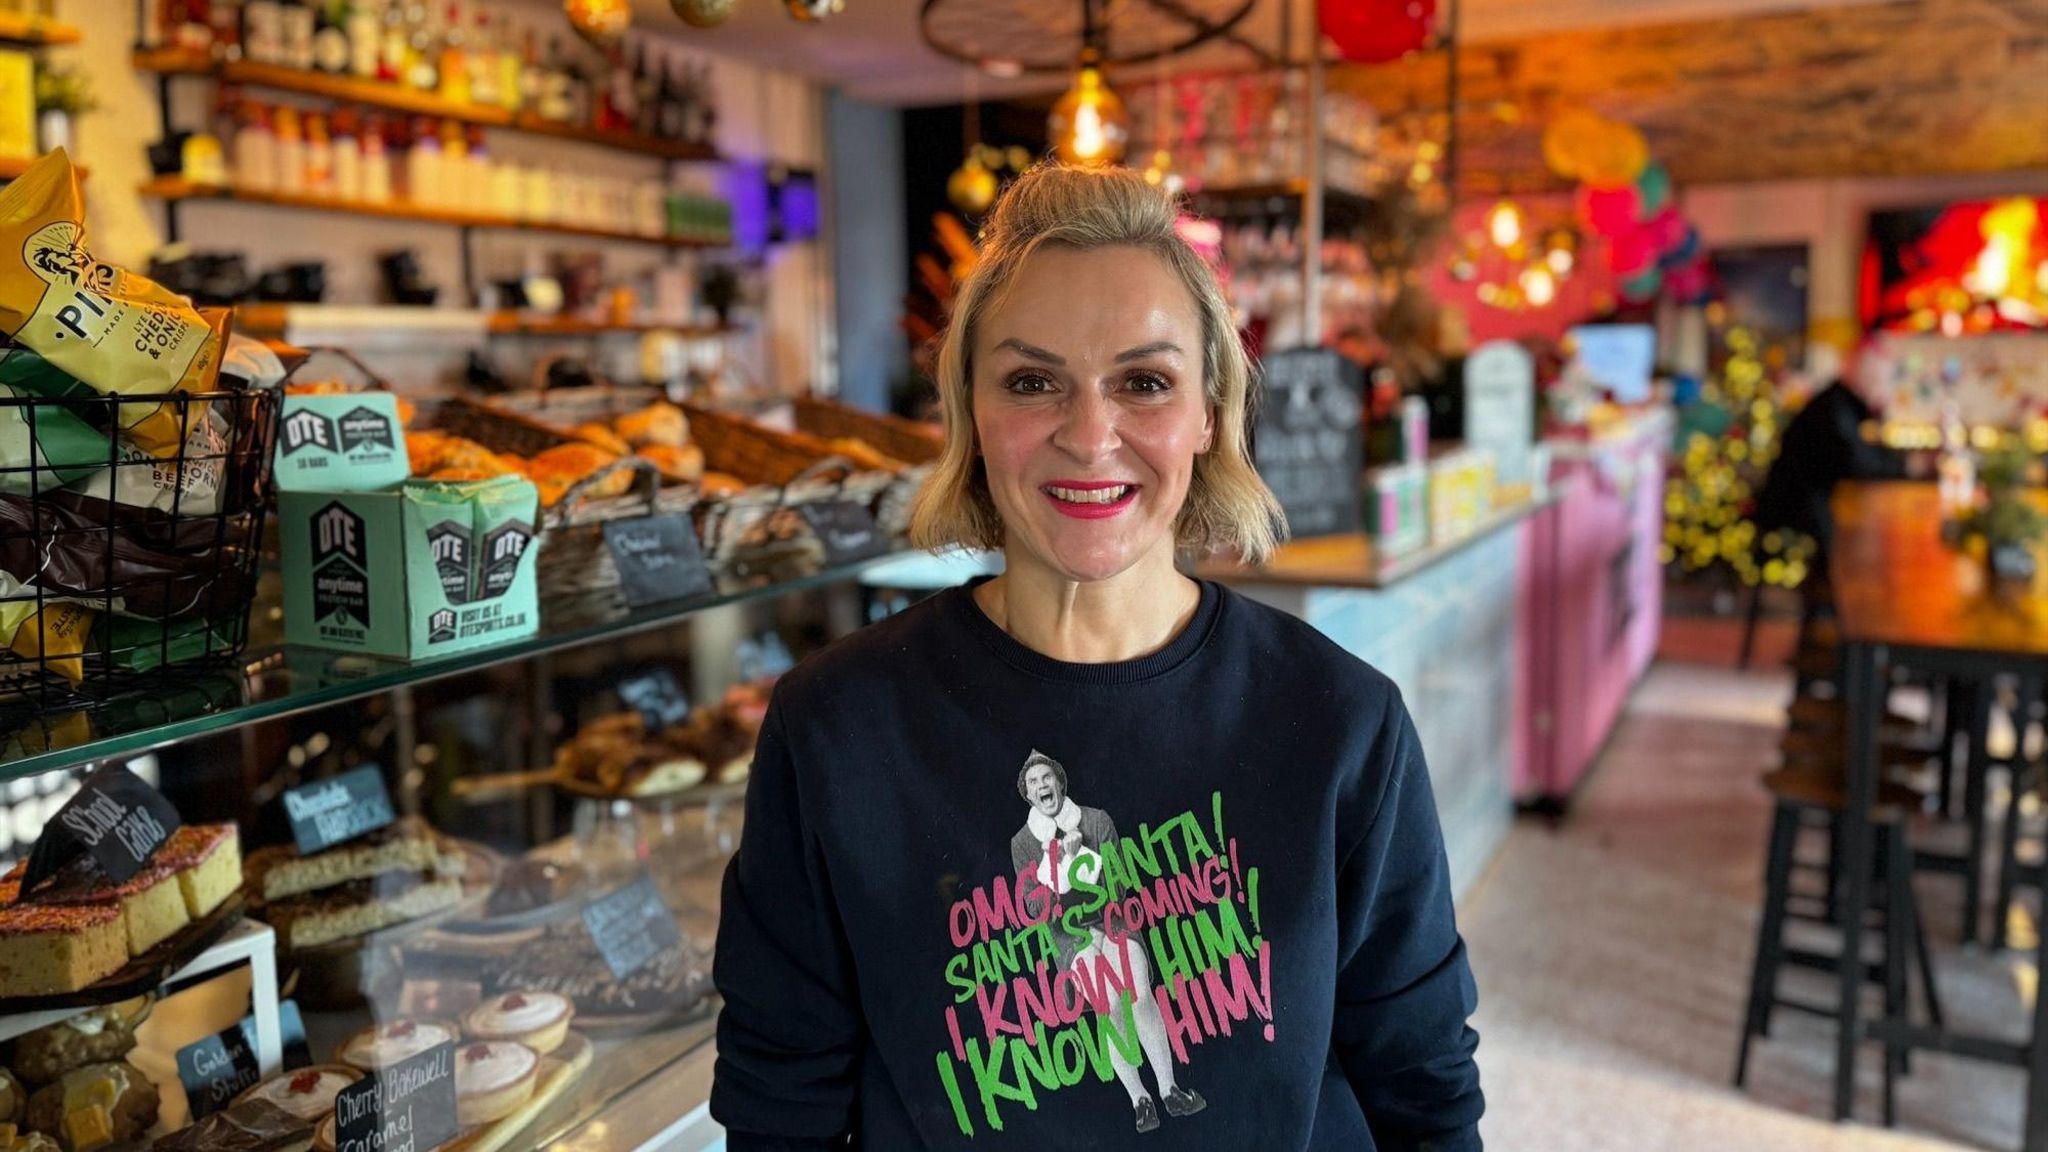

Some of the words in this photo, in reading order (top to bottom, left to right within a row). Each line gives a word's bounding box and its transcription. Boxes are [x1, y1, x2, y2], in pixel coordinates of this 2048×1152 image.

[103, 309, 125, 336] MADE
[148, 347, 161, 360] &
[286, 411, 329, 448] OTE
[319, 506, 358, 558] OTE
[494, 530, 525, 560] OTE
[433, 610, 455, 631] OTE
[949, 838, 1063, 947] OMG!
[1067, 790, 1229, 914] SANTA!
[1104, 837, 1246, 940] COMING!
[945, 1005, 967, 1063] I
[975, 930, 1138, 1047] KNOW
[1149, 867, 1264, 1000] HIM!
[936, 1050, 974, 1139] I
[965, 989, 1143, 1132] KNOW
[1155, 940, 1276, 1065] HIM!
[336, 1080, 385, 1127] Cherry
[387, 1049, 450, 1104] Bakewell
